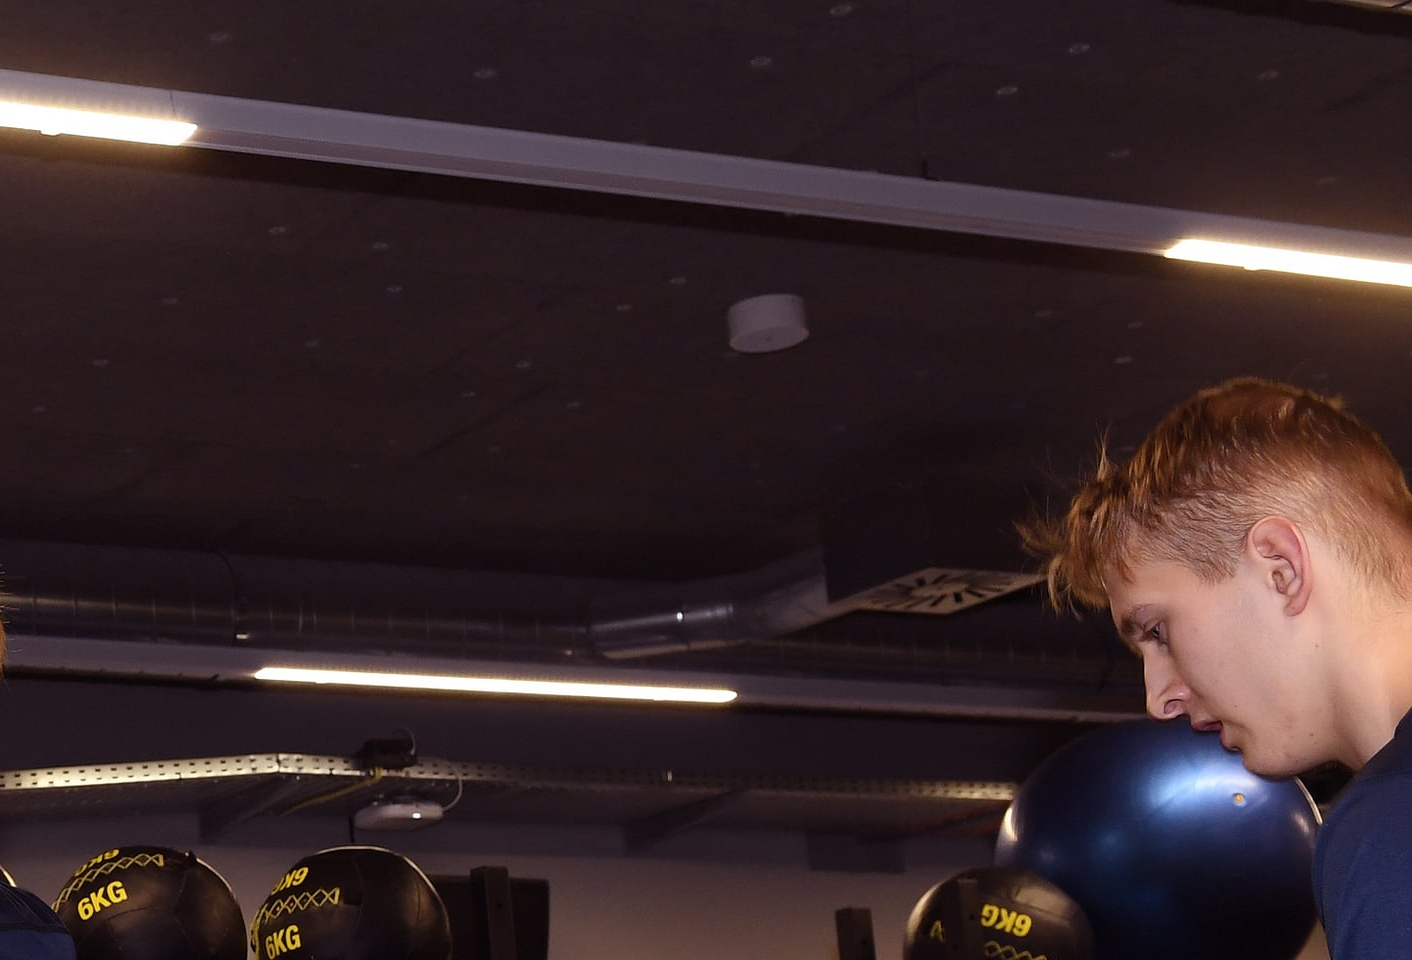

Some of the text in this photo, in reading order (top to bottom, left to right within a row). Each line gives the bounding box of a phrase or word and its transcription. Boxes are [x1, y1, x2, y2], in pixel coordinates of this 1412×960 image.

[76, 880, 128, 921] 6KG
[980, 903, 1033, 938] 6KG
[265, 924, 302, 960] 6KG
